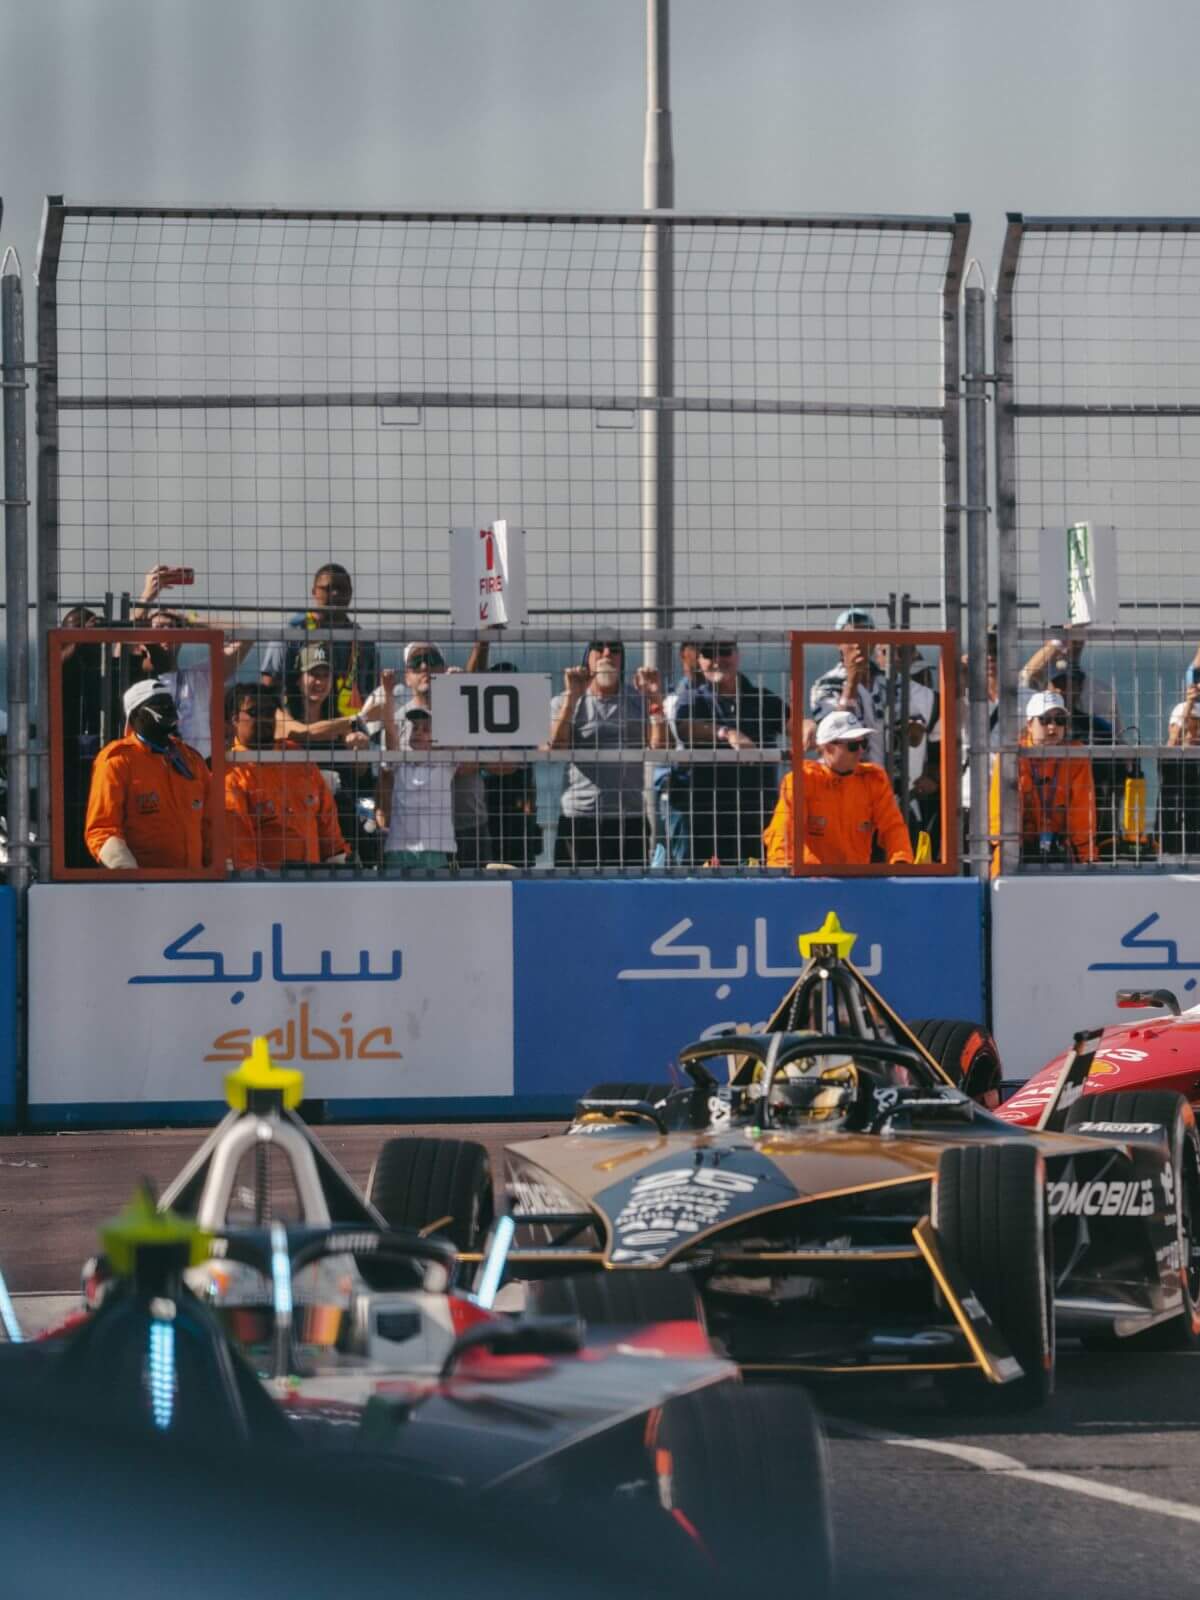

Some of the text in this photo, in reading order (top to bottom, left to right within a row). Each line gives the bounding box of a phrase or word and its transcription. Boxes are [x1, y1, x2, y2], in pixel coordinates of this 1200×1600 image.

[480, 575, 503, 595] FIRE
[460, 685, 520, 734] 10
[127, 922, 403, 1005] سابك
[203, 1001, 402, 1062] sabic
